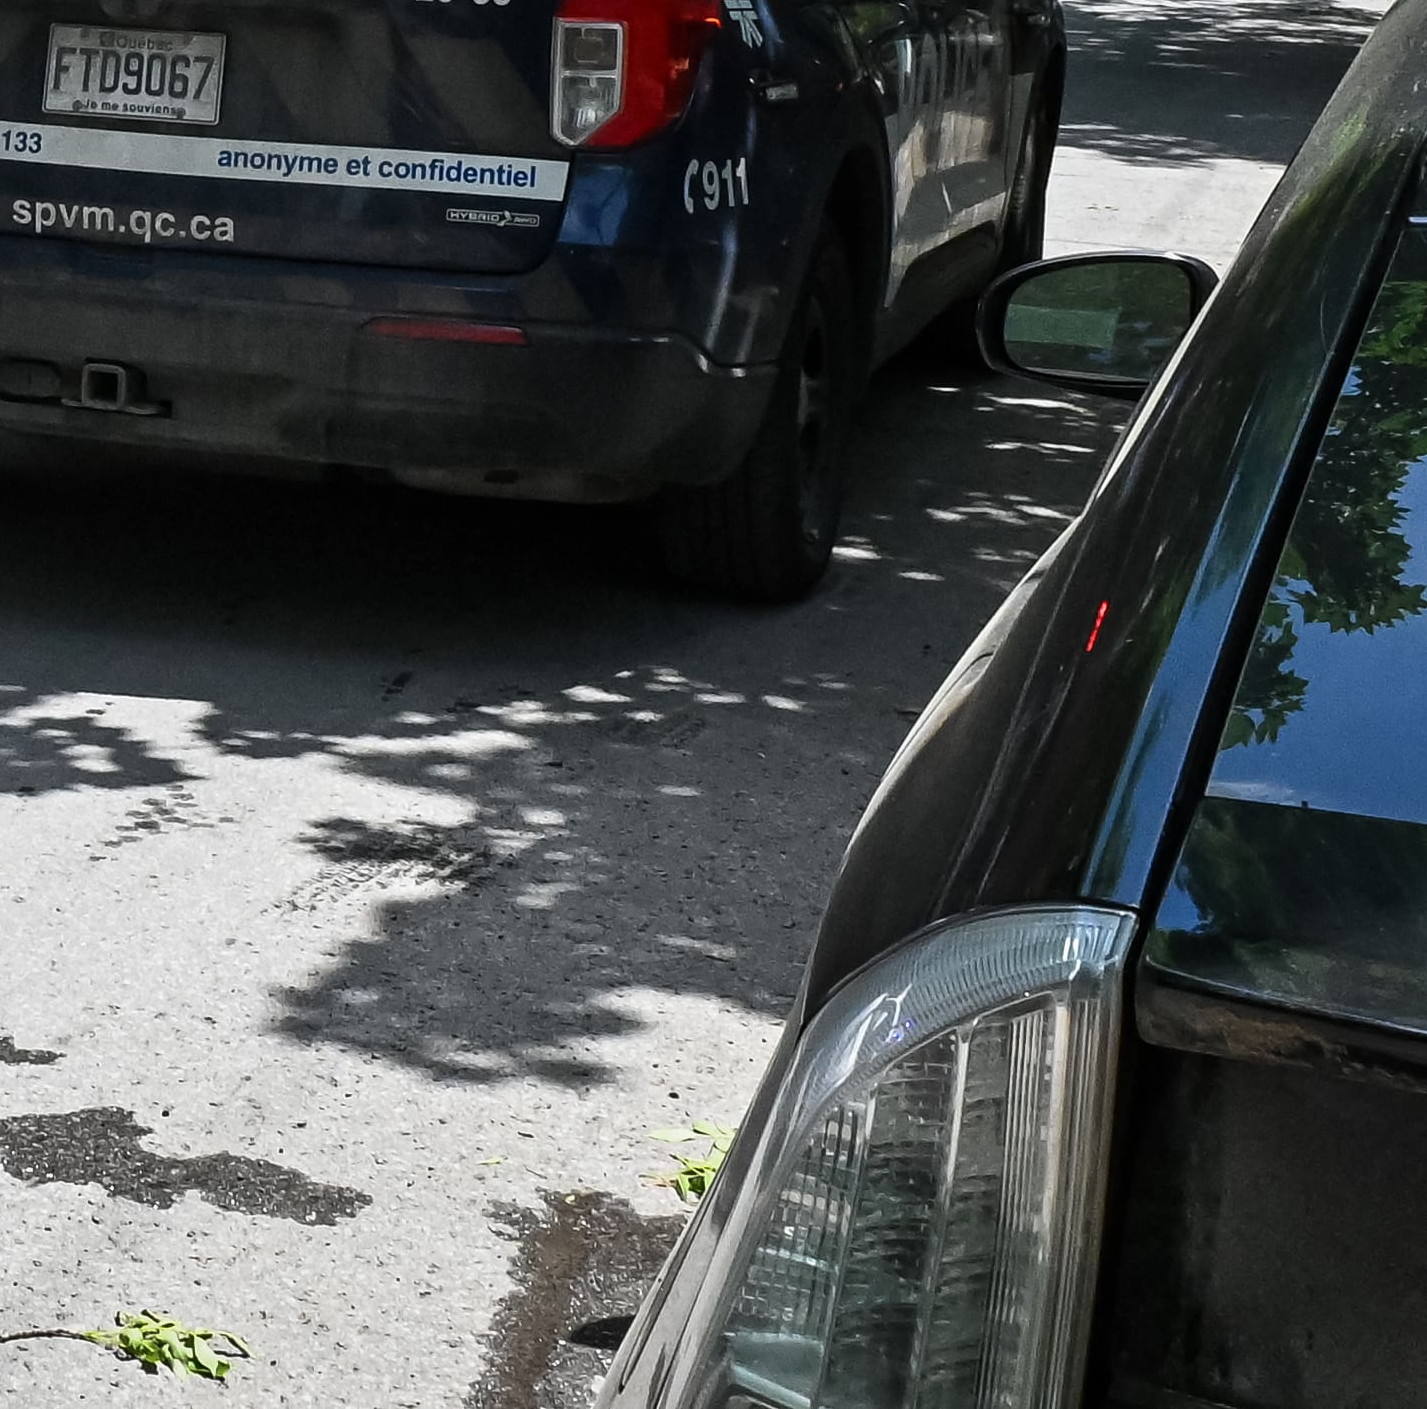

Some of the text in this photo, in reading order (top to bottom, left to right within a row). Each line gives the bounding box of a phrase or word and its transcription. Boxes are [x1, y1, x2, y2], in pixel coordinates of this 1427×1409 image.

[53, 46, 215, 100] FTD9067
[101, 102, 119, 112] me
[217, 149, 537, 188] anonyme et confidentiel
[702, 157, 749, 211] 911
[12, 199, 235, 243] spvm.qc.ca
